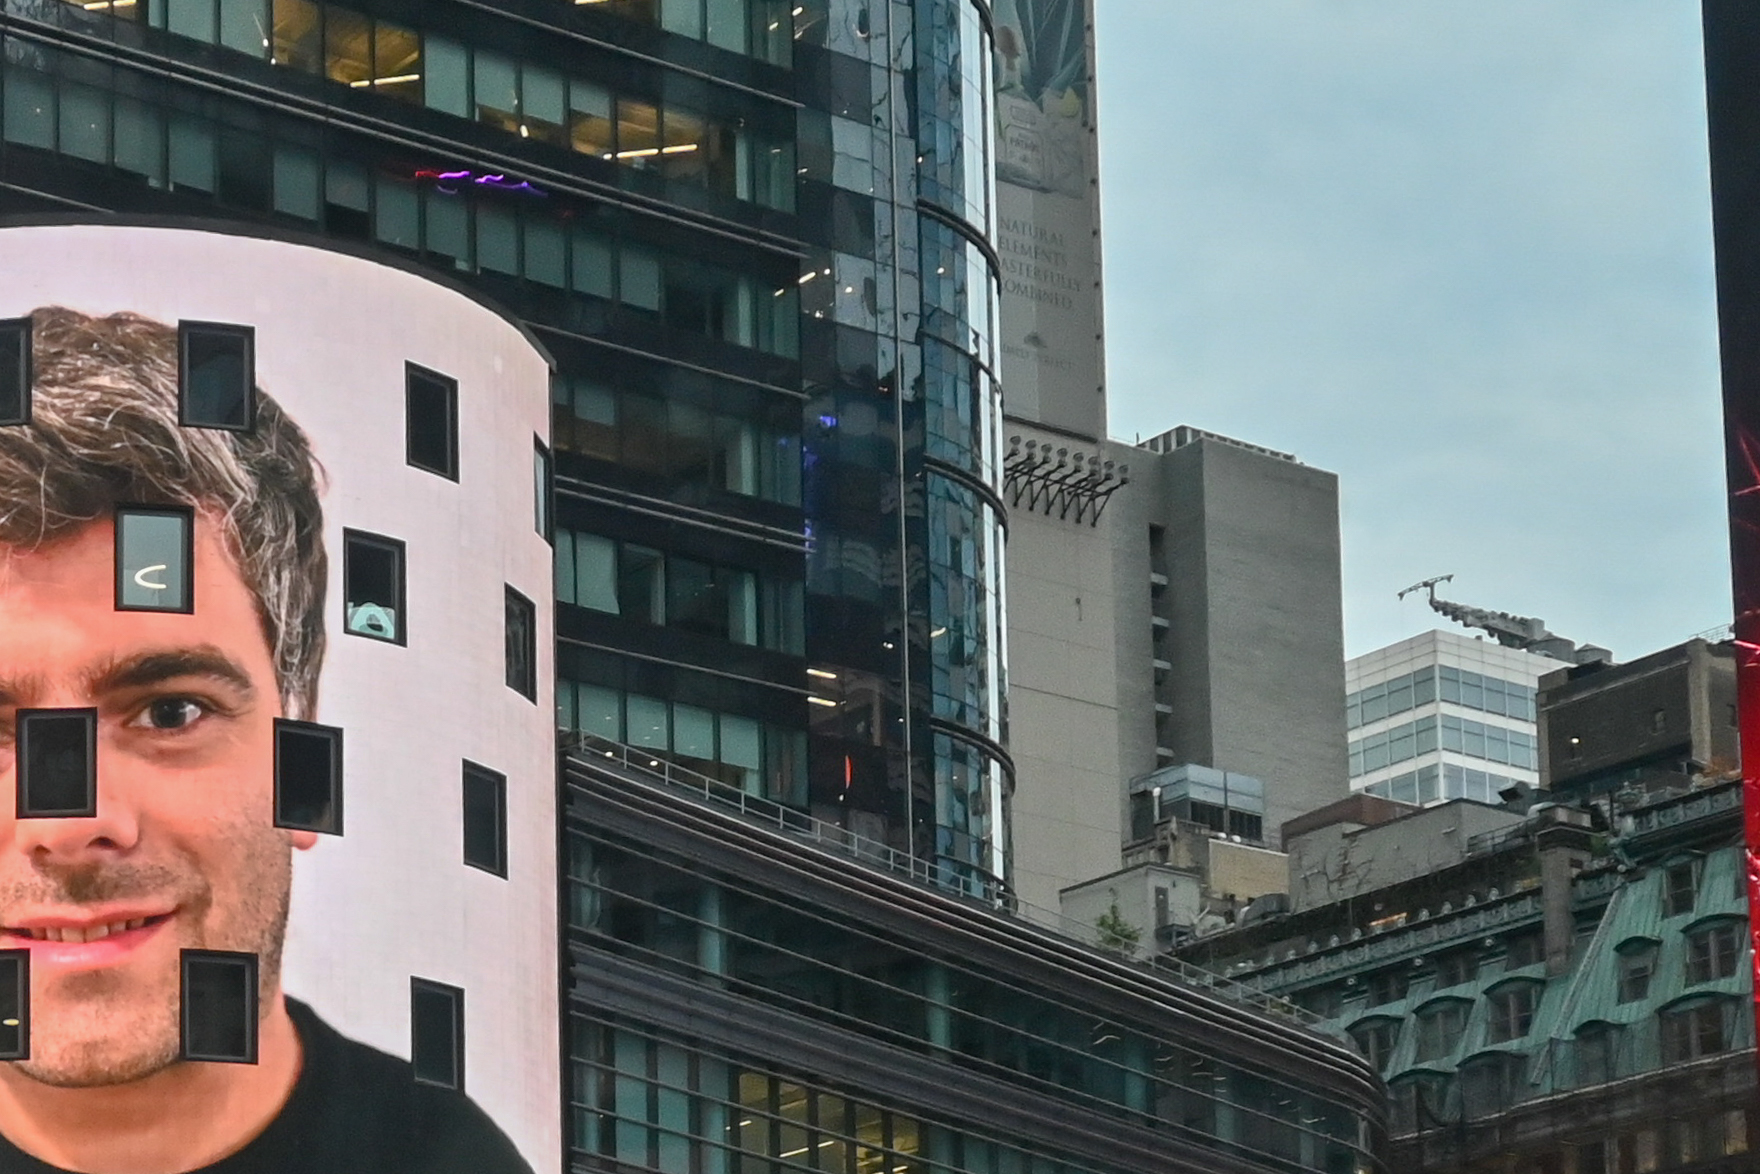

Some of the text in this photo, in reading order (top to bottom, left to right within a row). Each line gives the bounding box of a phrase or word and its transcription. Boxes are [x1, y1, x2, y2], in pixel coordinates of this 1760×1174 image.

[999, 216, 1064, 246] NATURAL
[998, 235, 1068, 268] ELEMENTS
[1000, 257, 1081, 293] ASTERFULLY
